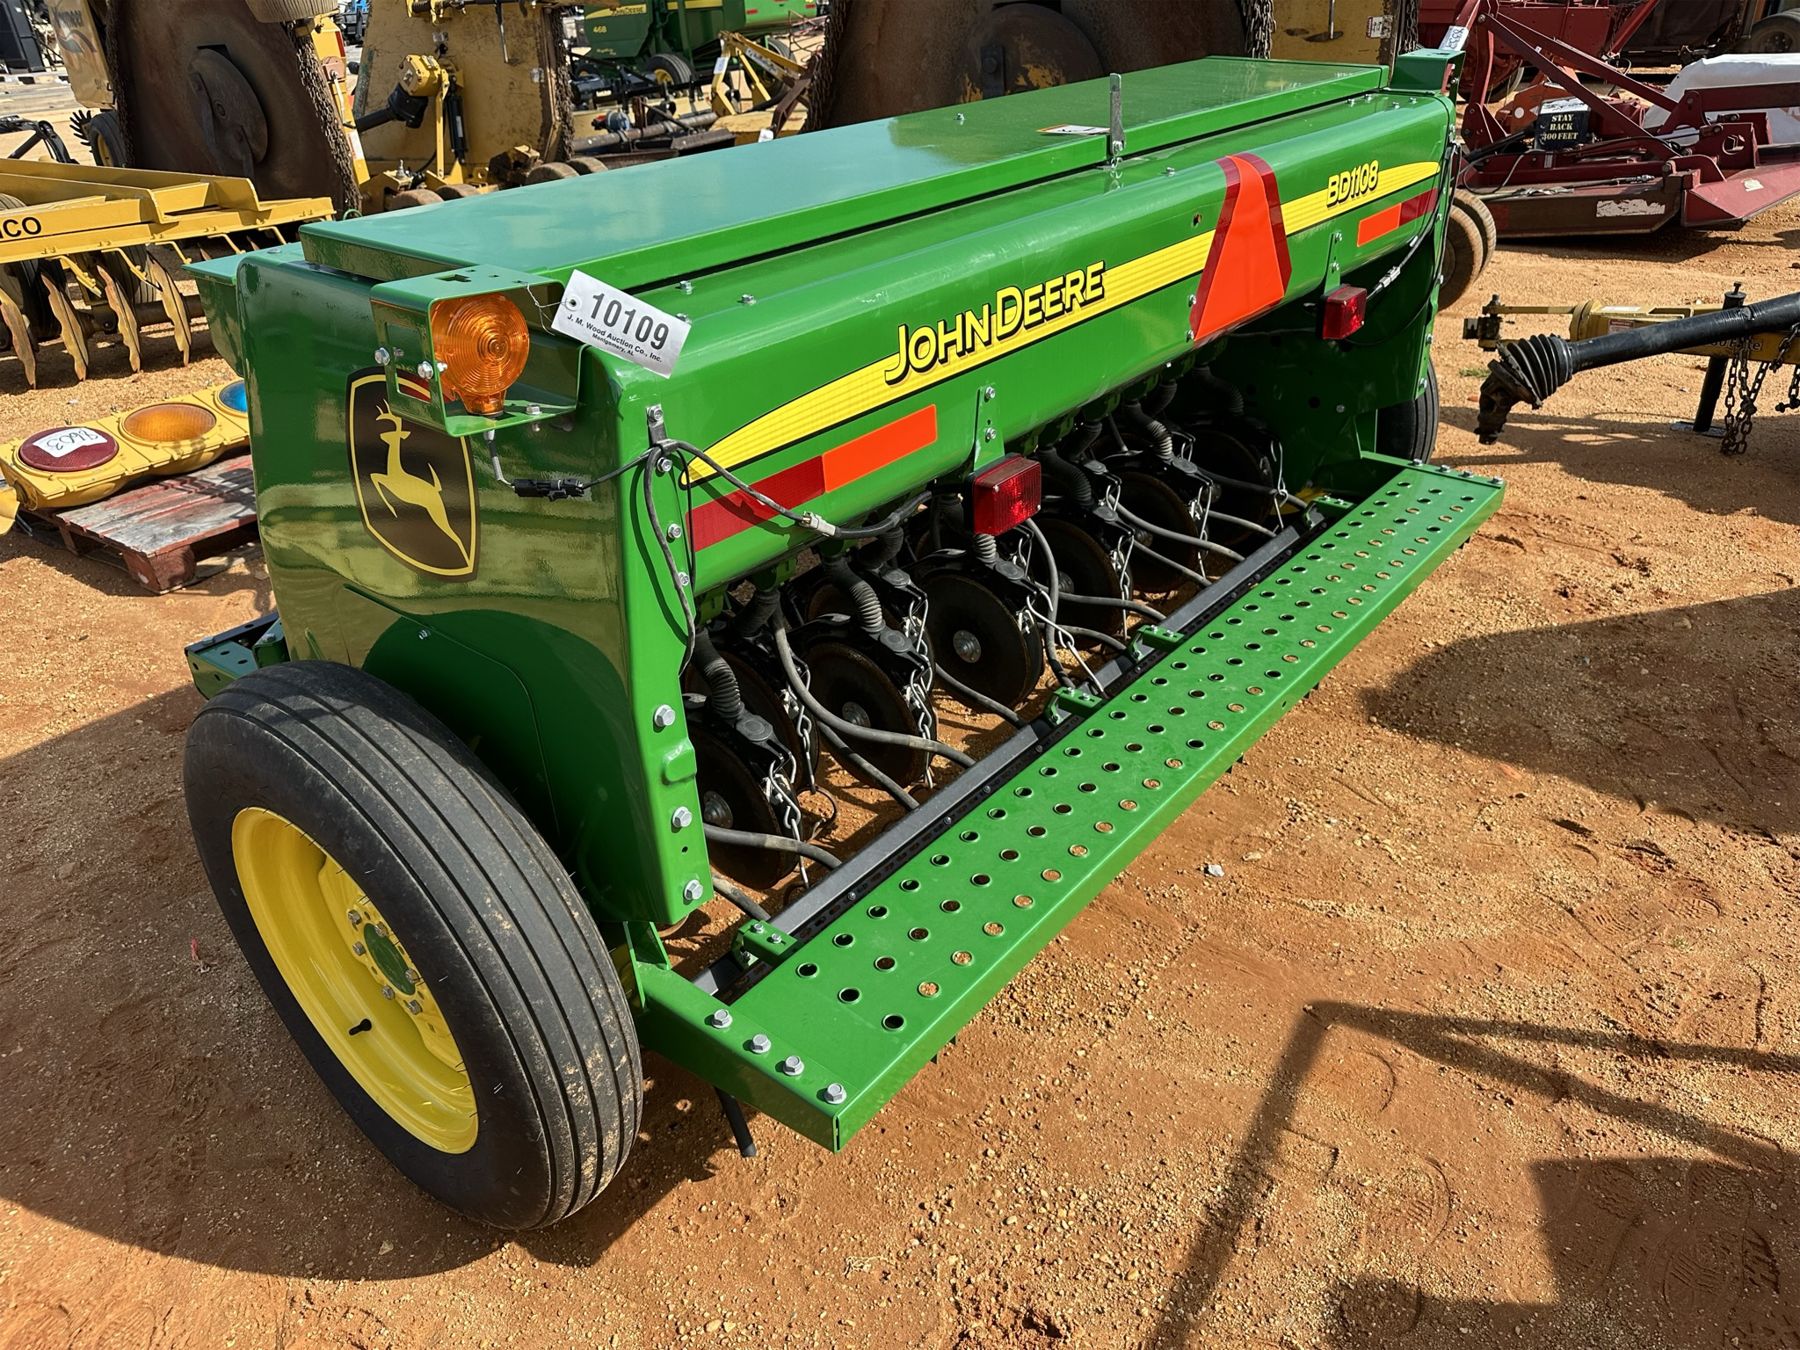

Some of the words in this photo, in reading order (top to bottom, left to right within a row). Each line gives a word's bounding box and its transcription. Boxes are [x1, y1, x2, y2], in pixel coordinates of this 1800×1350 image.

[1550, 123, 1573, 131] BACK
[1552, 114, 1574, 122] STAY
[1557, 132, 1578, 140] FEET
[1327, 160, 1379, 208] BD1108
[0, 217, 42, 239] CO
[591, 293, 669, 350] 10109
[884, 302, 991, 385] JOHN
[996, 260, 1104, 341] DEERE
[575, 317, 584, 326] M.
[586, 322, 606, 336] Wood
[606, 333, 633, 350] Auction
[634, 345, 648, 357] Co.,
[649, 352, 662, 363] Inc.
